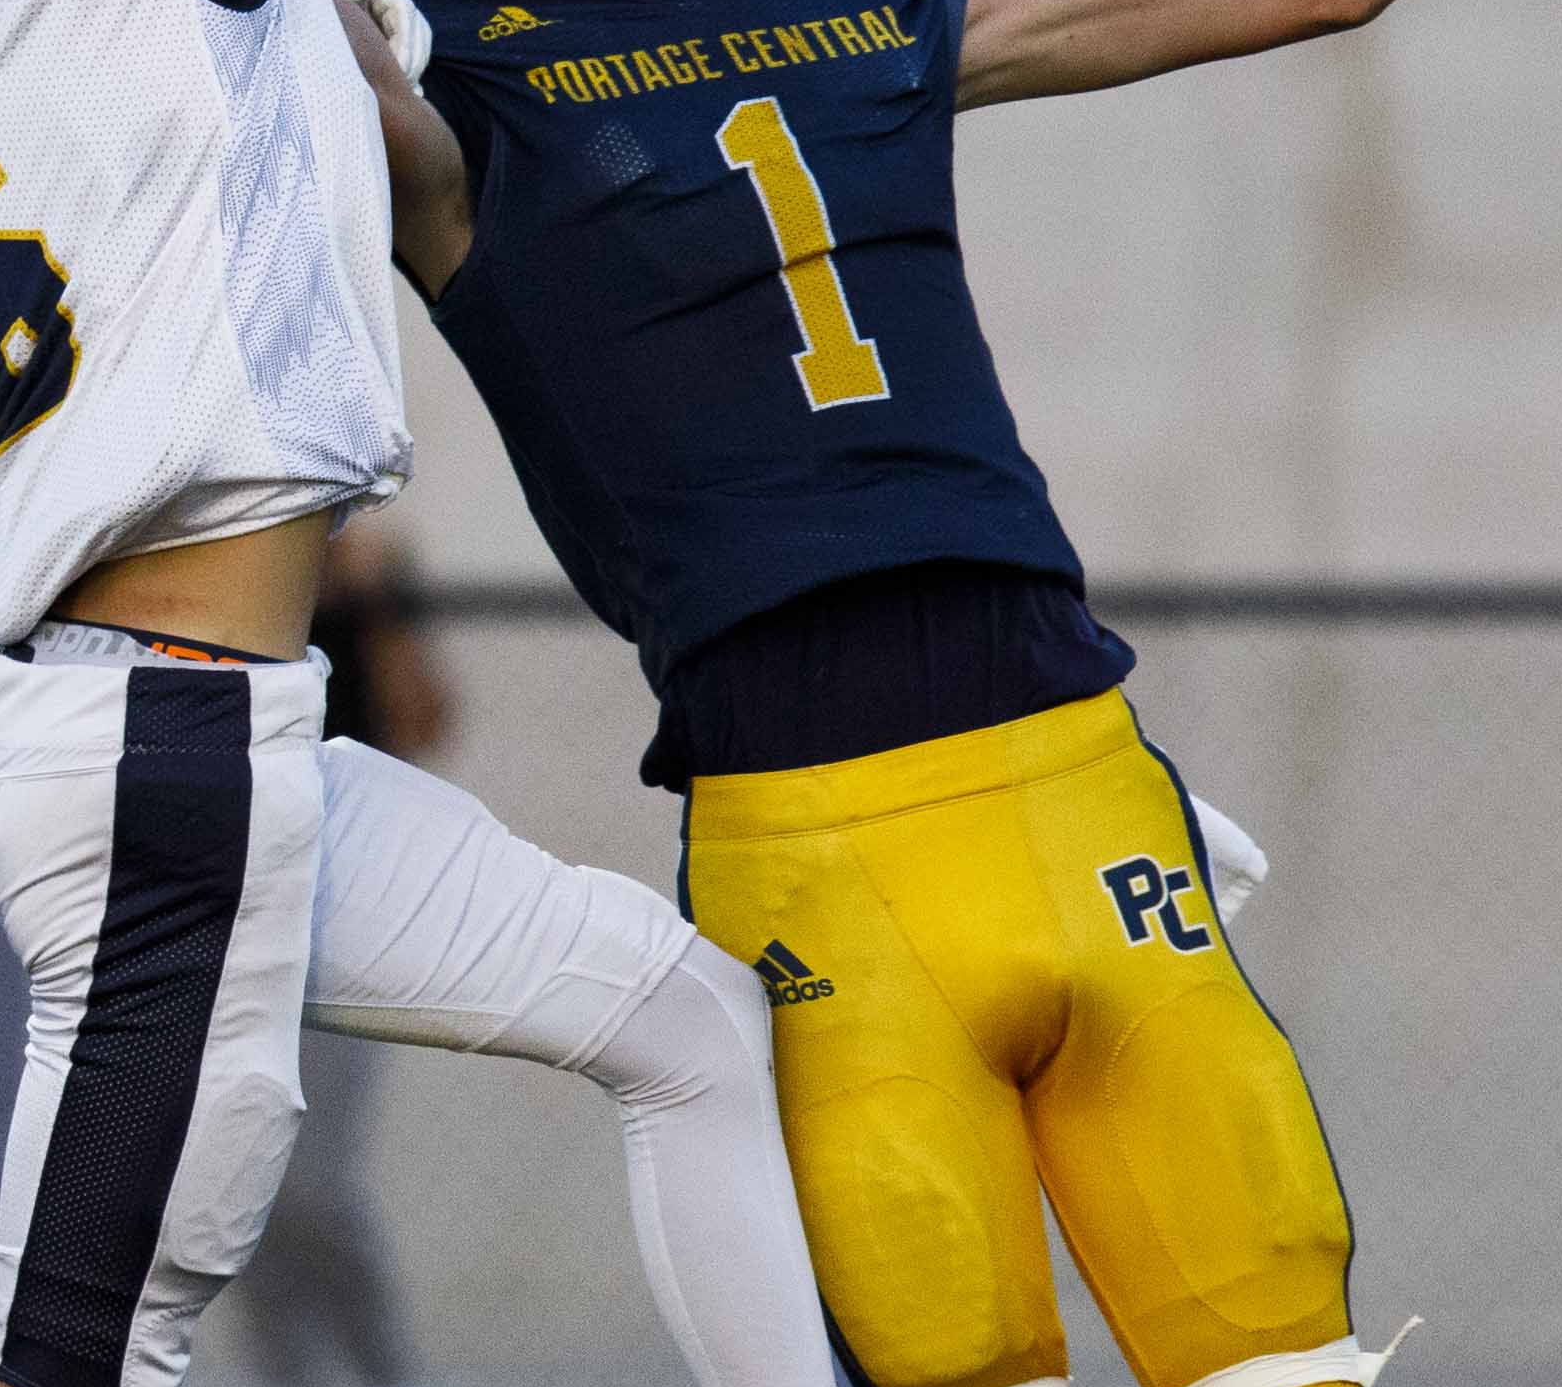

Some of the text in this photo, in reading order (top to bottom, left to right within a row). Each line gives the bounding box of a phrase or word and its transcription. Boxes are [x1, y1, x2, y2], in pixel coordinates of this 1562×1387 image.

[526, 5, 917, 104] PORTAGE CENTRAL
[715, 96, 891, 413] 1
[1096, 854, 1214, 954] PC
